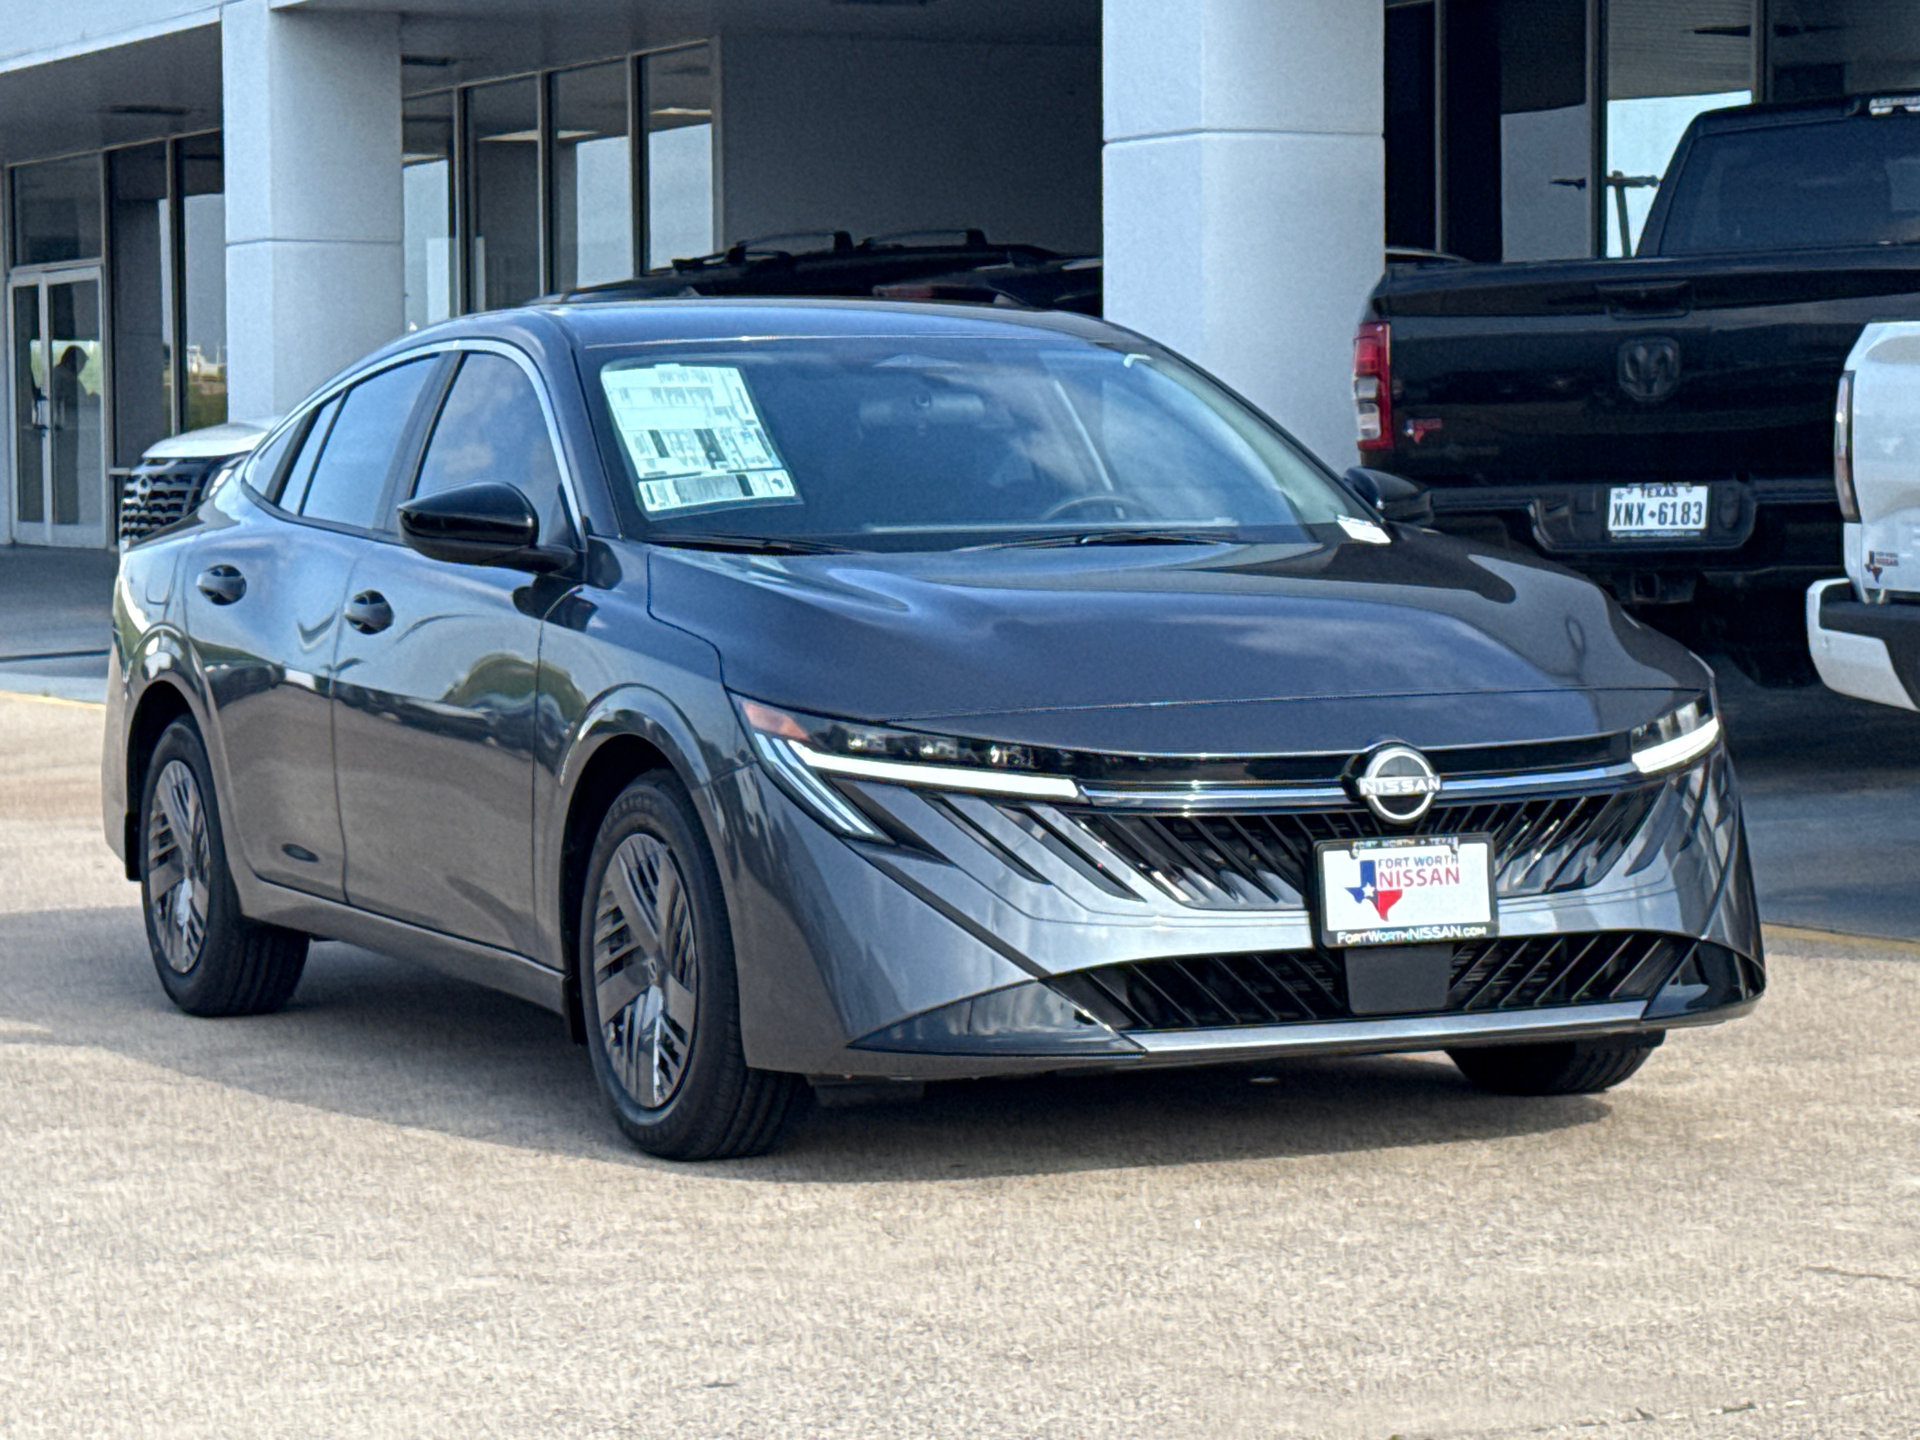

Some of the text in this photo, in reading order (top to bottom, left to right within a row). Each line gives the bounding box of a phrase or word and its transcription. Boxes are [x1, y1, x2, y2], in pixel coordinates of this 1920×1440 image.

[1640, 485, 1678, 498] TEXAS
[1360, 778, 1441, 795] NISSAN
[1378, 854, 1459, 869] FORT WORTH
[1379, 866, 1460, 888] NISSAN
